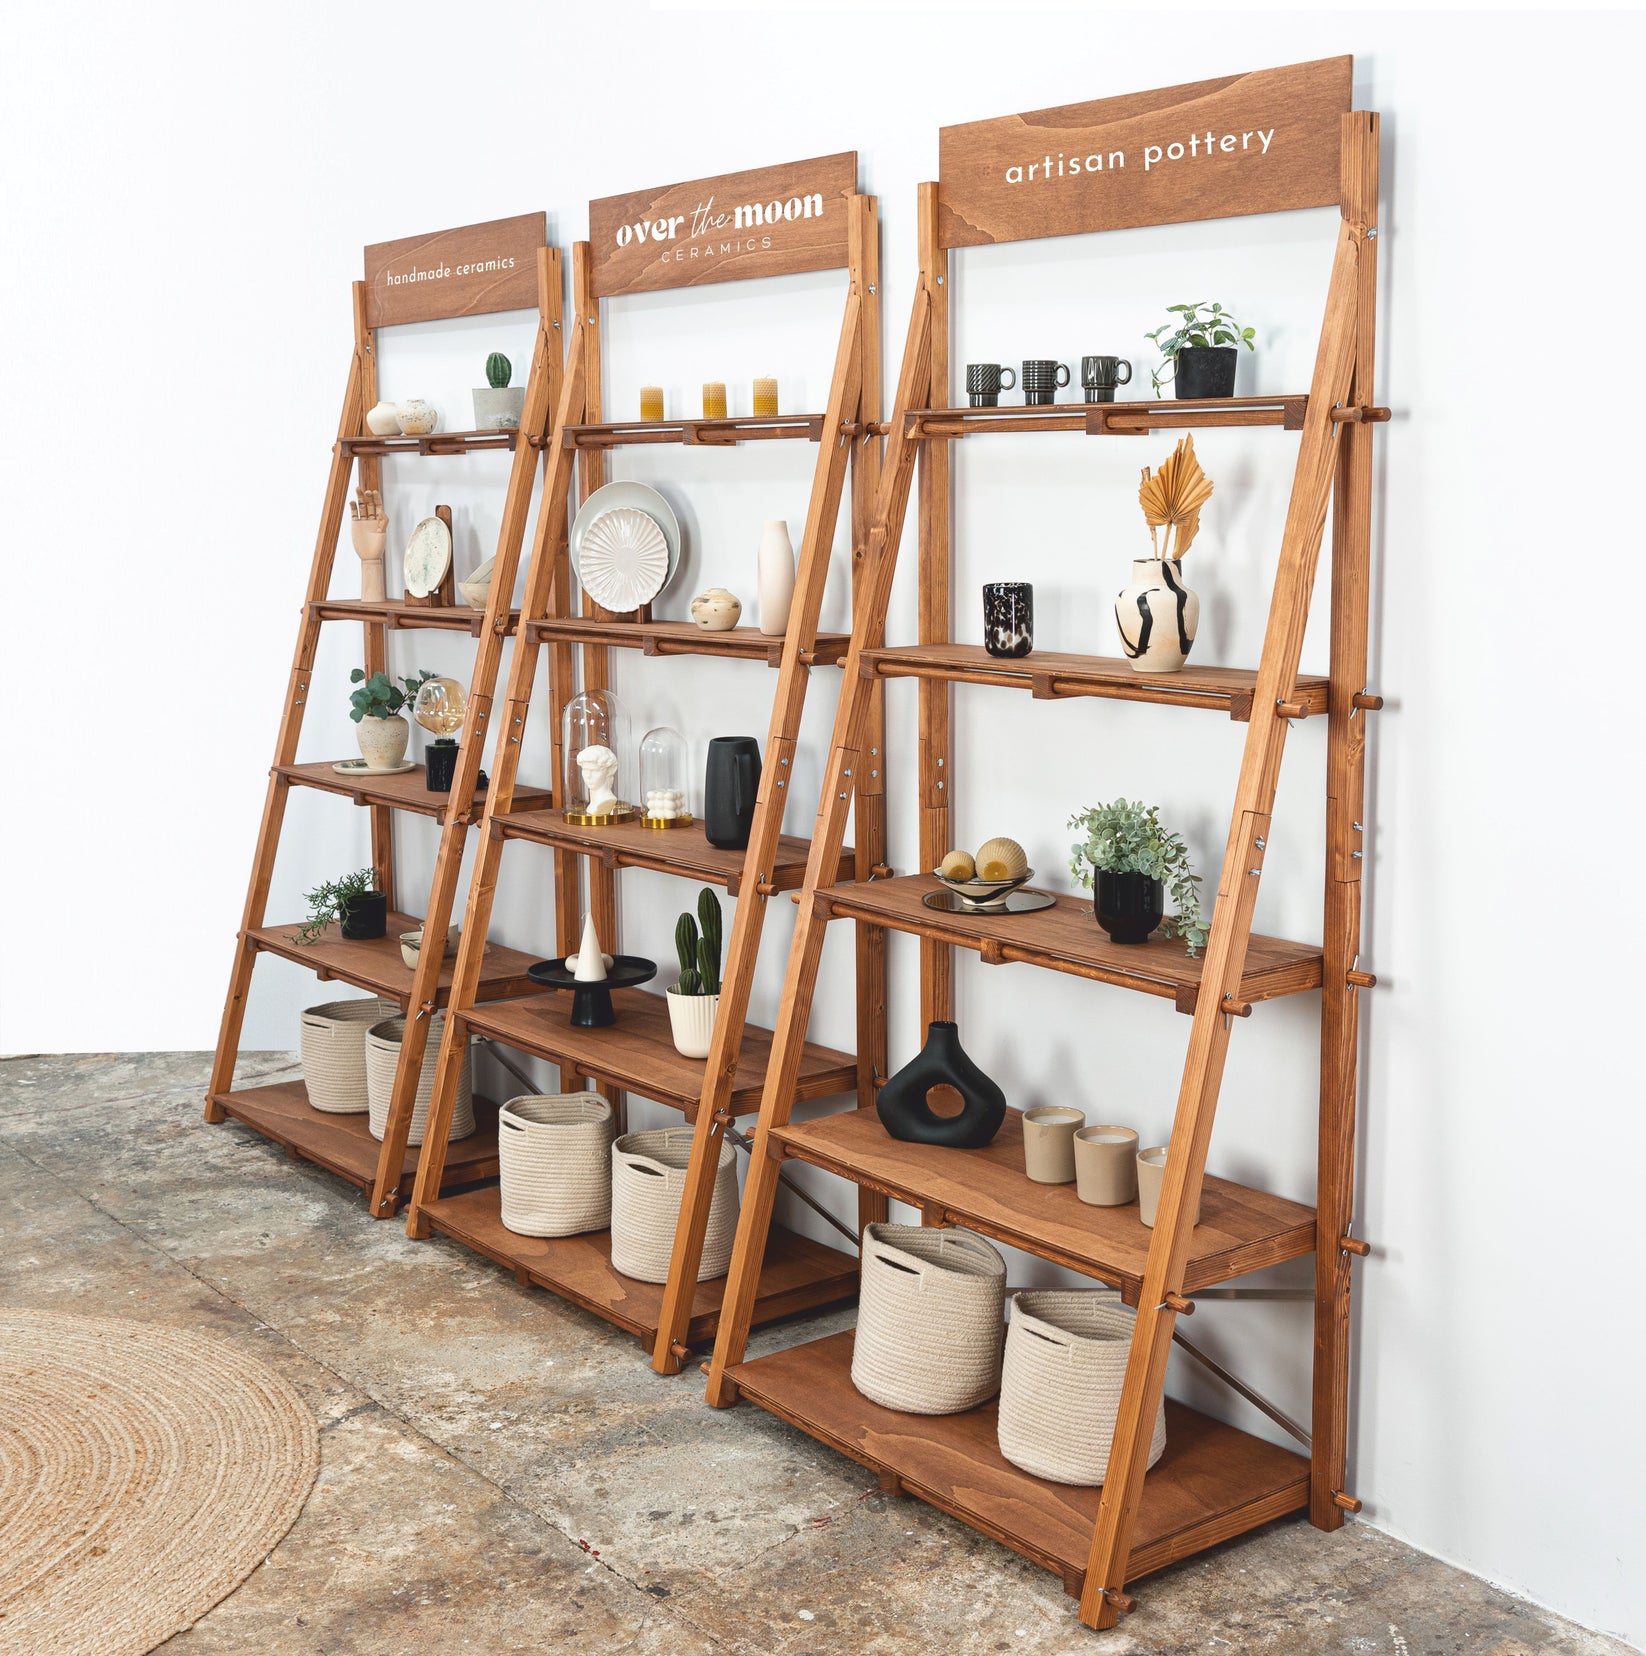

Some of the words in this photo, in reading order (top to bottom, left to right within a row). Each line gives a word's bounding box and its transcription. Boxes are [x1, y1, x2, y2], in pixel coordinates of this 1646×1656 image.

[1005, 150, 1125, 185] artisan
[1144, 128, 1275, 171] pottery
[616, 215, 684, 247] over
[689, 195, 733, 239] the
[734, 193, 824, 229] moon
[661, 236, 772, 263] CERAMICS
[387, 262, 450, 286] handmade
[456, 256, 515, 276] ceramics
